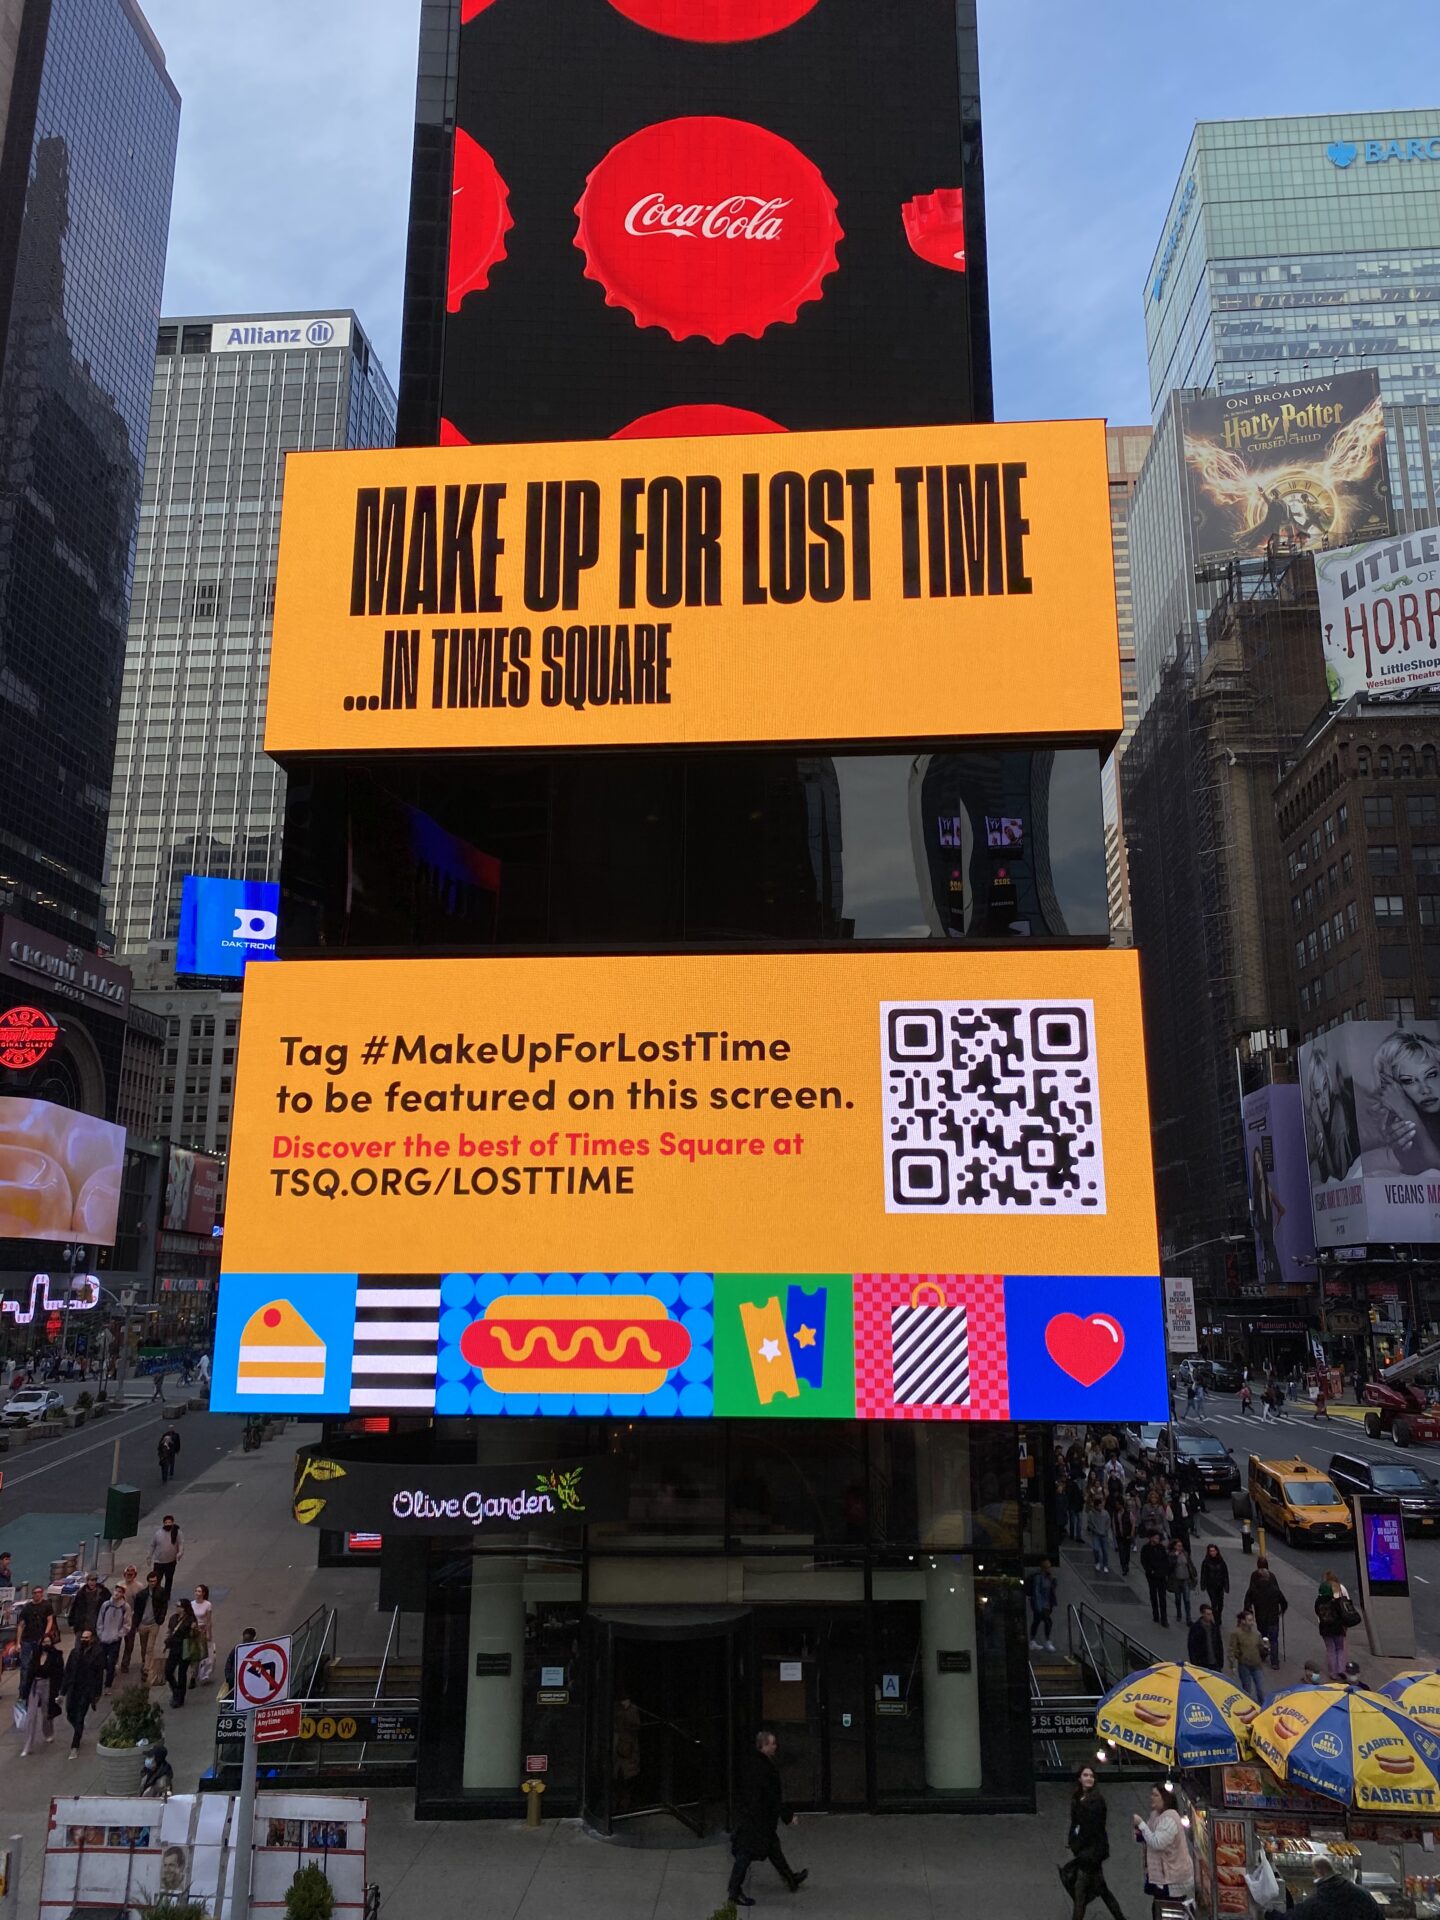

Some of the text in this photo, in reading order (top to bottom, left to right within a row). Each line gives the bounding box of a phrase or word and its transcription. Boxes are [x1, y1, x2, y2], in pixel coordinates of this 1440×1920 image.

[1364, 136, 1440, 163] BARC
[624, 192, 794, 241] Coca-Cola
[227, 327, 302, 345] Allianz
[1220, 402, 1344, 449] Harry Potter
[1247, 433, 1321, 453] CURSED CHILD
[350, 462, 1032, 616] MAKE UP FOR LOST TIME
[1340, 534, 1440, 600] LITTLE
[1417, 571, 1437, 583] OF
[429, 627, 532, 709] TIMES
[541, 625, 671, 711] SQUARE
[1366, 669, 1440, 690] Westside Theatre
[221, 940, 275, 950] DAKTRONI
[8, 1011, 39, 1025] HOT
[279, 1031, 791, 1076] Tag #MakeUpForLostTime
[277, 1079, 854, 1114] to be featured on this screen.
[272, 1131, 805, 1163] Discover the best of Times Square at
[271, 1166, 634, 1201] TSQ.ORG/LOSTTIME
[1384, 1184, 1425, 1204] VEGANS
[1335, 1314, 1361, 1325] TSQ
[392, 1489, 554, 1526] Olive Garden
[886, 1678, 896, 1691] A
[1122, 1693, 1173, 1706] SABRETT
[257, 1707, 295, 1719] NO STANDING
[257, 1718, 281, 1727] Anytime
[1031, 1715, 1089, 1727] 9 St Station
[1272, 1706, 1310, 1725] SABRETT
[218, 1719, 233, 1729] 49
[303, 1722, 352, 1733] N R W
[1065, 1726, 1093, 1735] Brooklyn
[1099, 1719, 1173, 1760] SABRETT
[1358, 1737, 1405, 1760] SABRETT
[1323, 1780, 1338, 1792] ROLL
[1360, 1785, 1436, 1805] SABRETT
